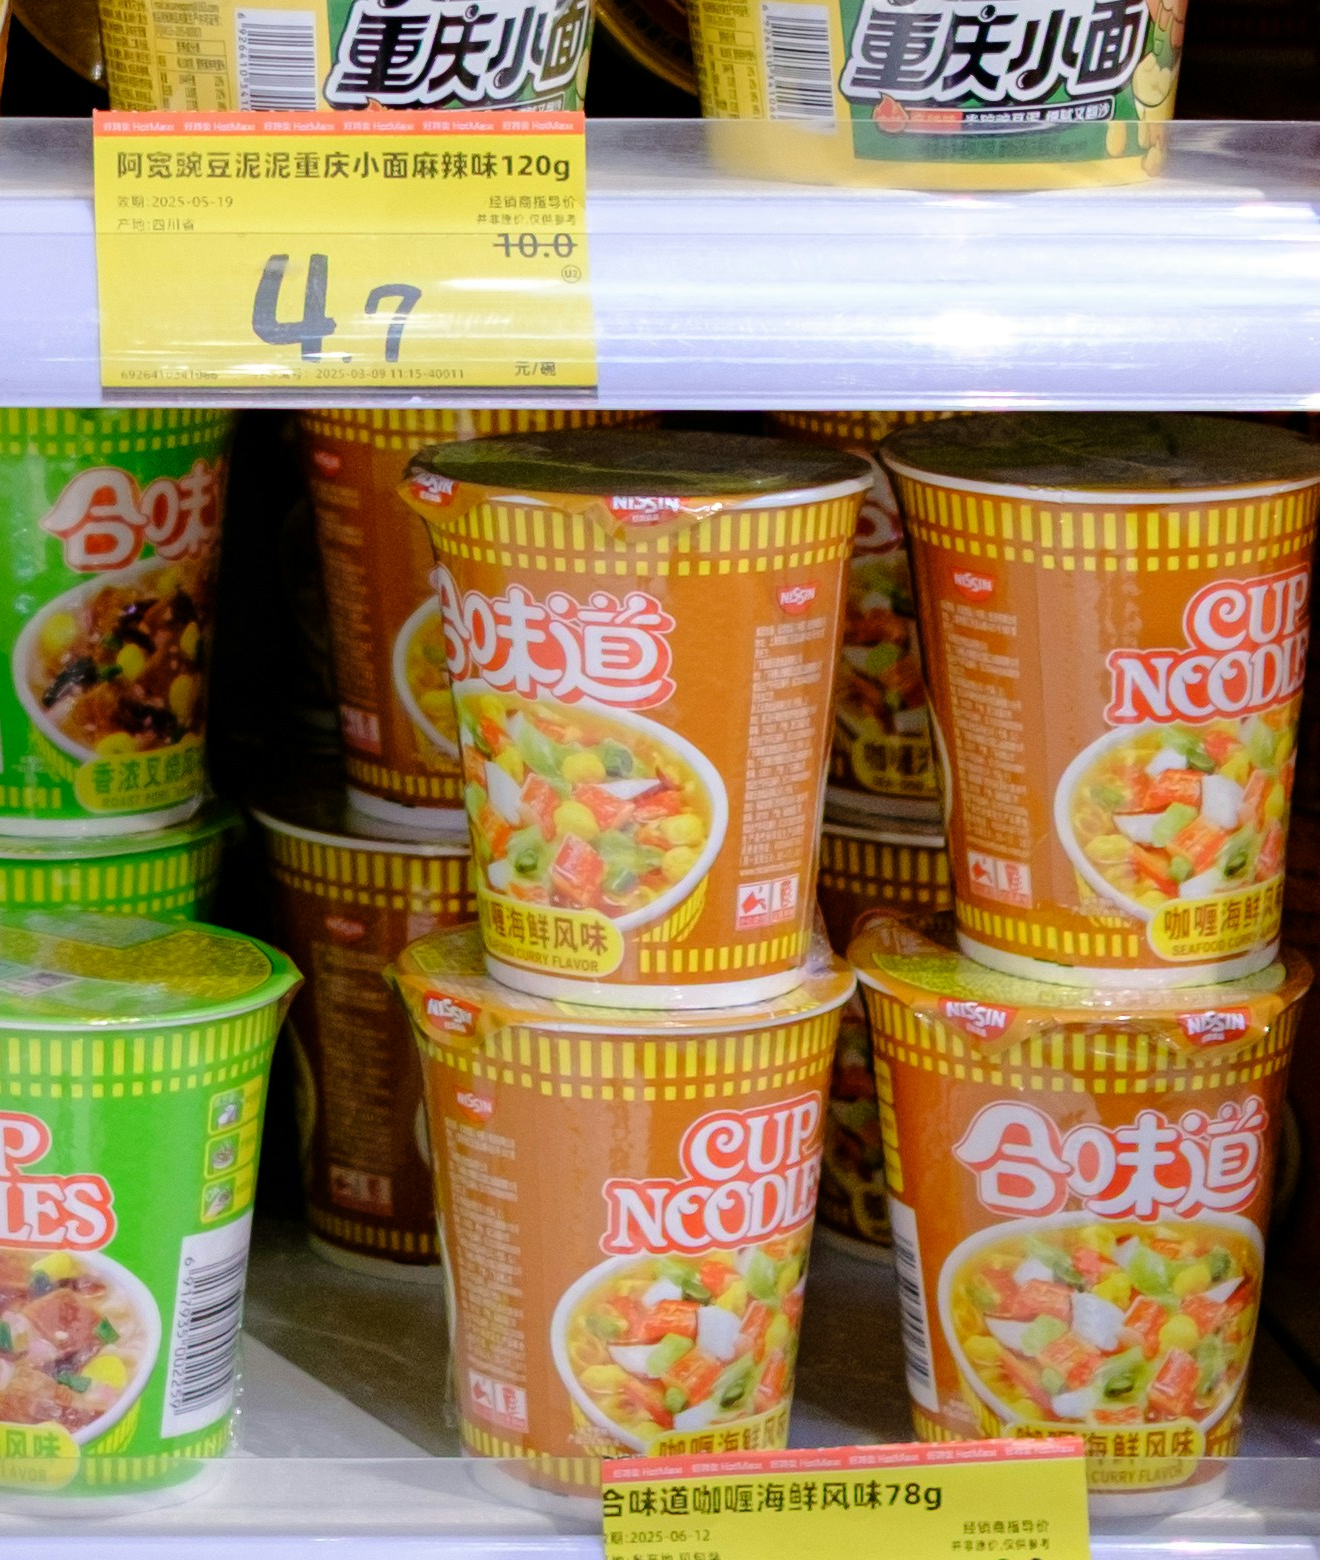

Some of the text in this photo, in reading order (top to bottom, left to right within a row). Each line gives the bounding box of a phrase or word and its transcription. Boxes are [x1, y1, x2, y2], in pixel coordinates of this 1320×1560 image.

[117, 151, 571, 182] 阿宽豌豆泥泥重庆小面麻辣味120g
[117, 194, 234, 209] 效期:2025-05-19
[488, 195, 576, 210] 经销商指导价
[493, 233, 577, 259] 10.0
[252, 253, 422, 364] 4.7
[514, 361, 557, 377] 元/碗
[955, 1101, 1265, 1217] 合味道
[603, 1481, 943, 1518] 合味道咖喱海鲜风味78g
